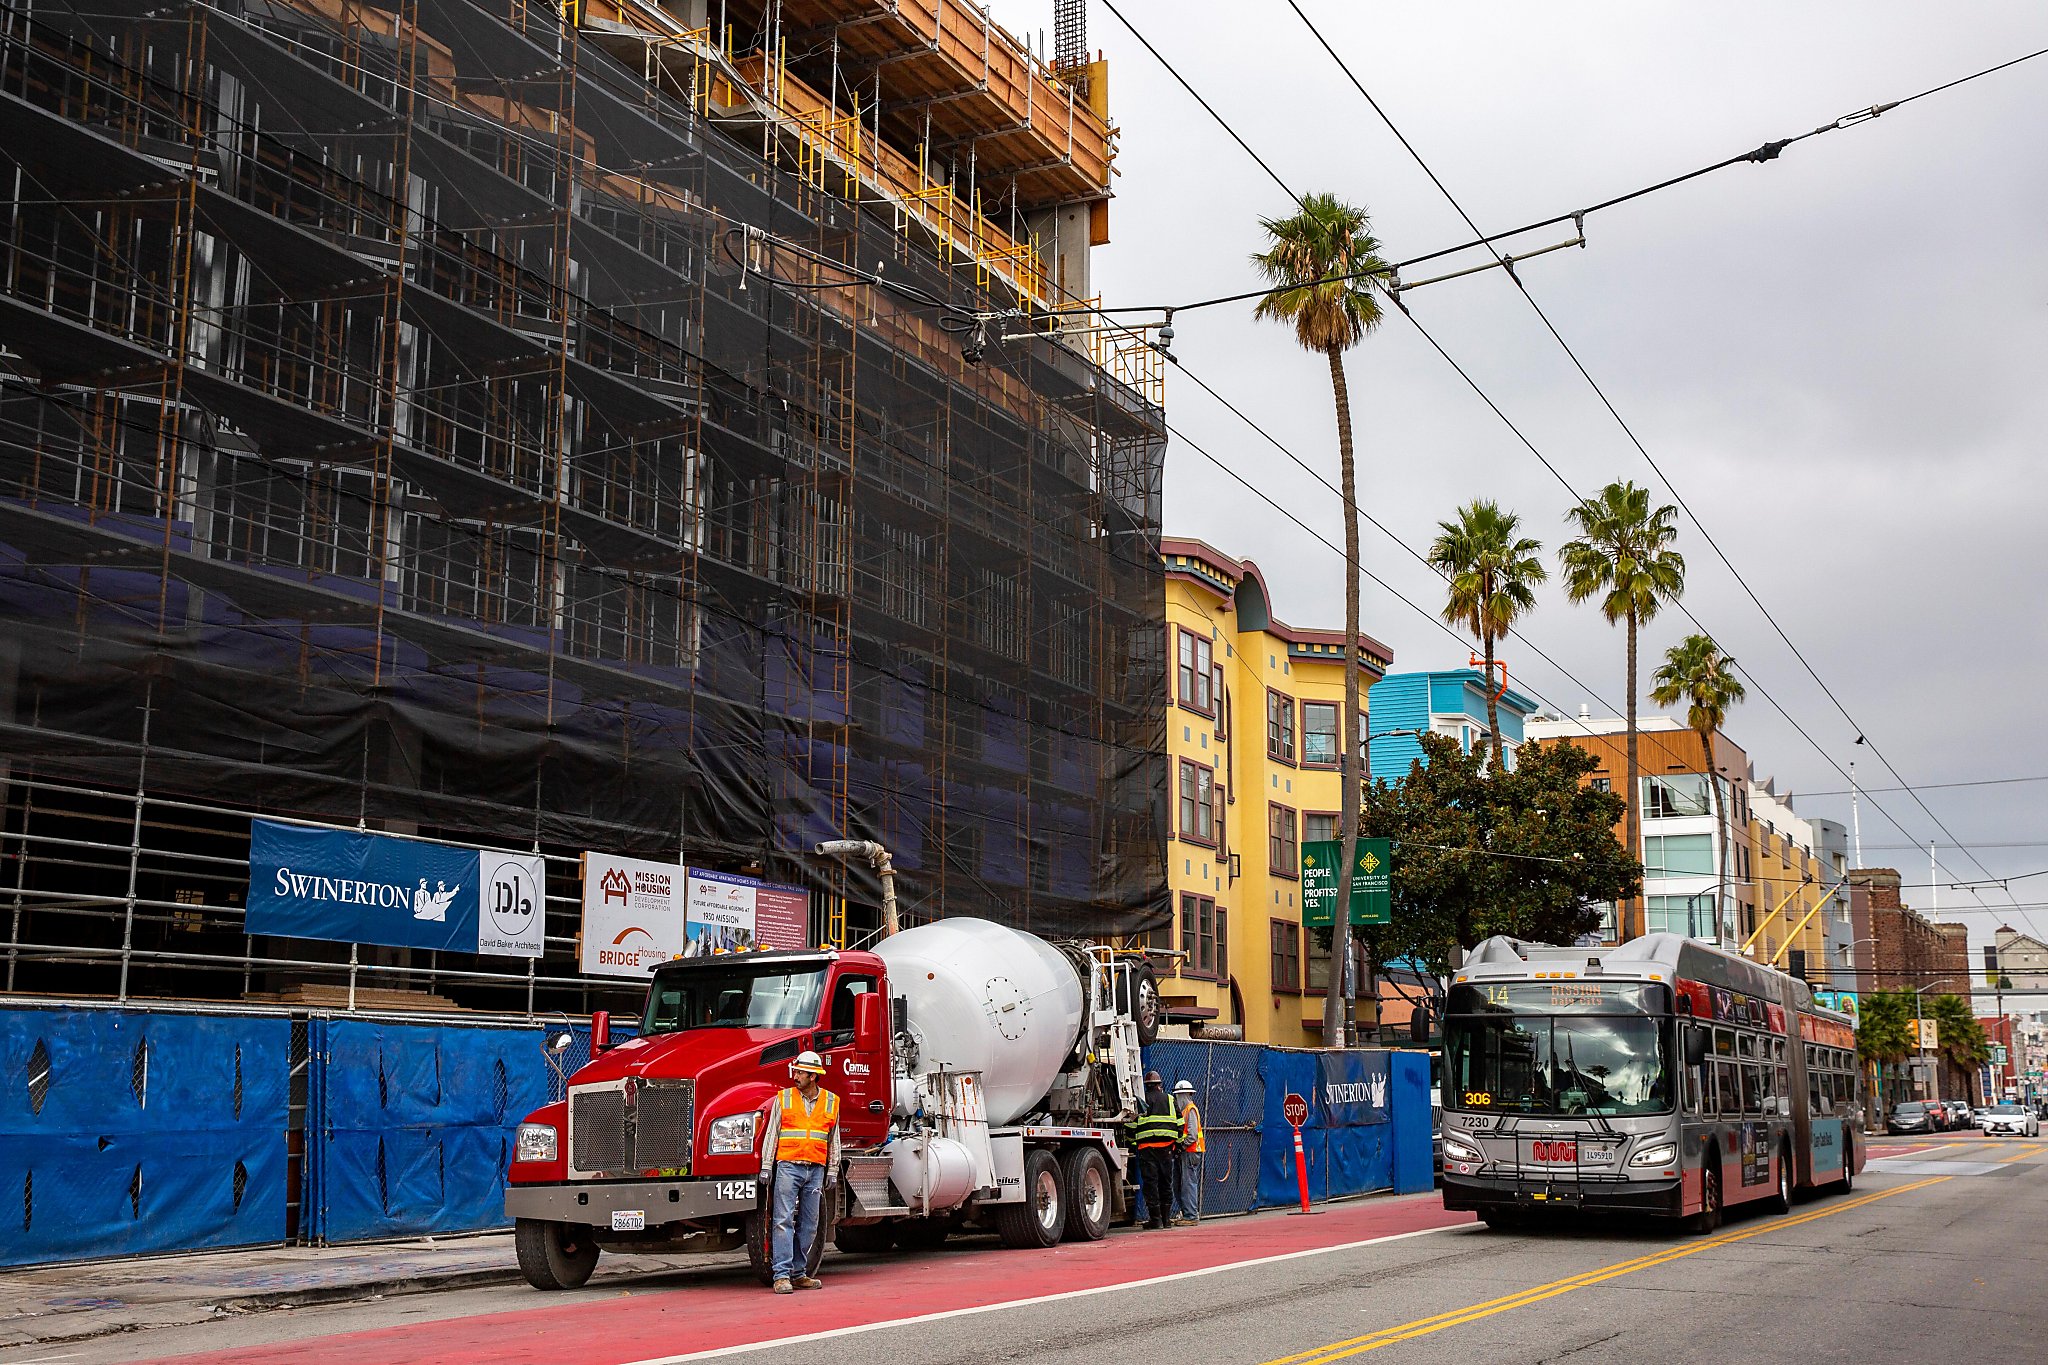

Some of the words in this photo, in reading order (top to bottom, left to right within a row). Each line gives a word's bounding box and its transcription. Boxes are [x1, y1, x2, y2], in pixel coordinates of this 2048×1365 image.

[635, 871, 671, 885] MISSION
[1304, 868, 1330, 877] PEOPLE
[274, 867, 410, 910] SWINERTON
[1304, 878, 1316, 888] OR
[635, 883, 671, 896] HOUSING
[1304, 887, 1338, 898] PROFITS?
[635, 896, 671, 906] DEVELOPMENT
[693, 899, 707, 907] FUTURE
[706, 902, 728, 910] AFFORDABLE
[729, 905, 744, 913] HOUSING
[1304, 898, 1321, 908] YES.
[635, 902, 671, 912] CORPORATION
[703, 912, 715, 921] 1950
[716, 914, 739, 924] MISSION
[480, 939, 496, 947] David
[497, 939, 514, 949] Baker
[515, 941, 541, 950] Architects
[599, 950, 640, 967] BRIDGE
[638, 946, 667, 962] Housing
[1487, 985, 1509, 1005] 14
[1551, 985, 1601, 996] MISSION
[1580, 997, 1602, 1006] City
[1465, 1092, 1491, 1105] 306
[1285, 1103, 1305, 1117] STOP
[1461, 1117, 1489, 1128] 7230
[715, 1180, 756, 1200] 1425
